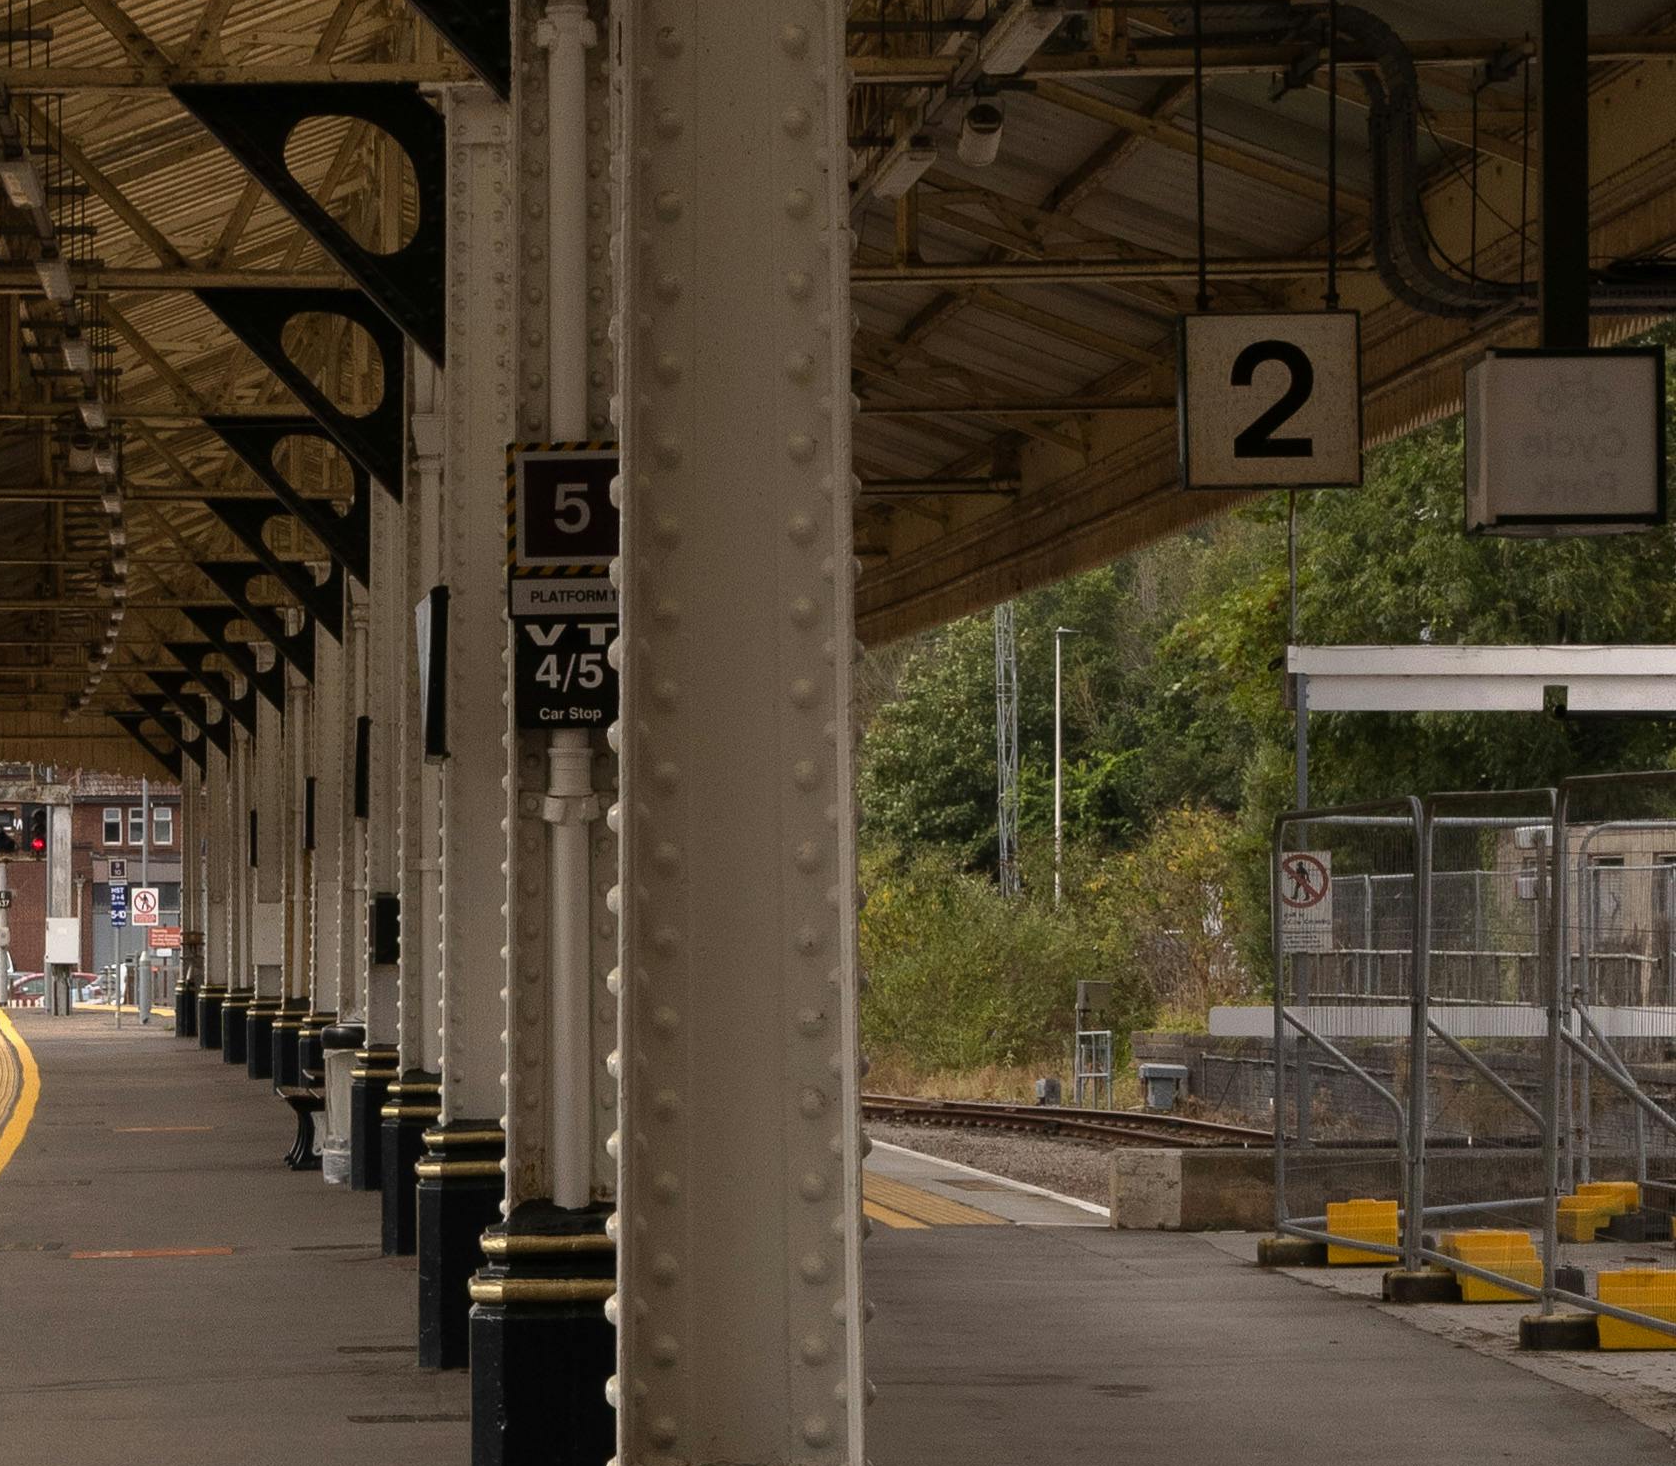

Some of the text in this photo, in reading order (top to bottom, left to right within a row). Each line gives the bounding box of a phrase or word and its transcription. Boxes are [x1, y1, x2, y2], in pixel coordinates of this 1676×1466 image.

[1230, 340, 1314, 458] 2
[554, 483, 591, 533] 5
[530, 590, 609, 604] PLATFORM
[535, 652, 604, 693] 4/5
[539, 707, 603, 723] Car Stop
